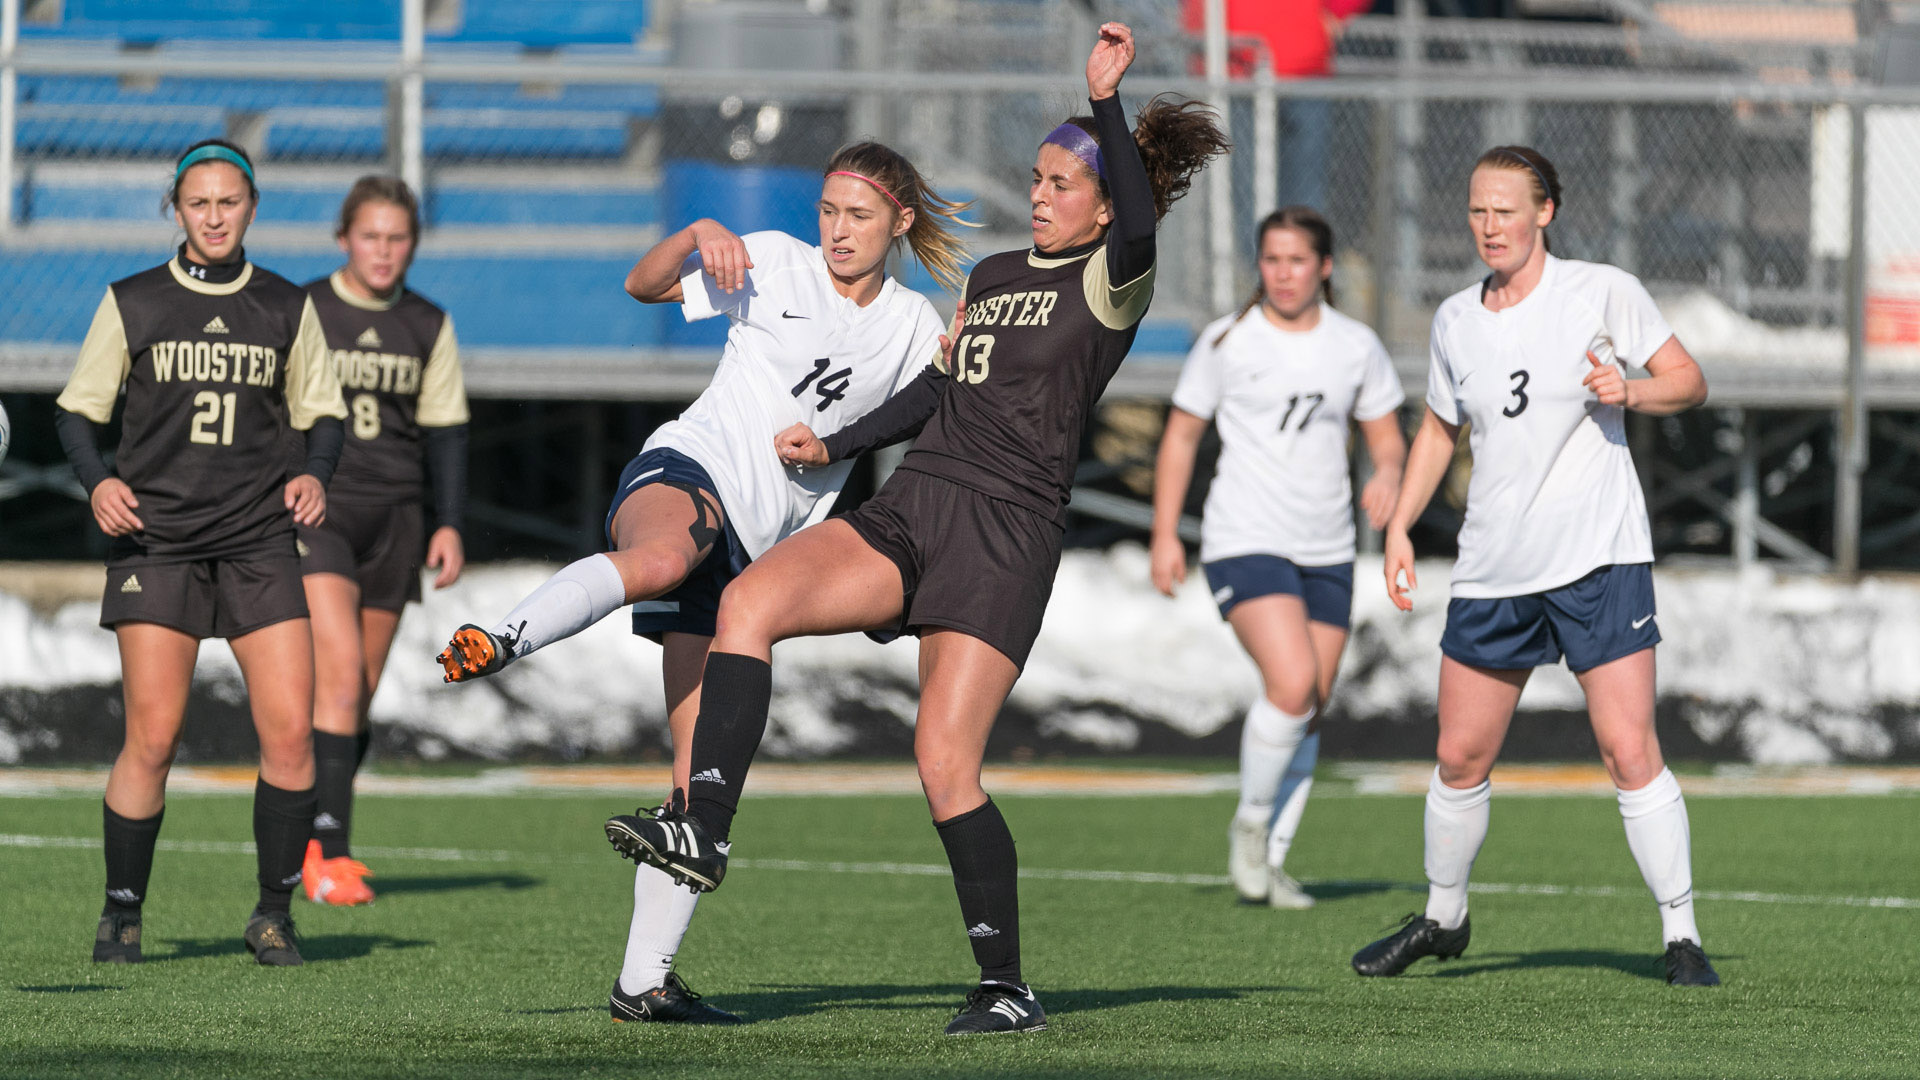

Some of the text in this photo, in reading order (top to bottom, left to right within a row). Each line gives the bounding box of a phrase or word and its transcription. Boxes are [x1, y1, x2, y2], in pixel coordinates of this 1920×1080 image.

[152, 341, 277, 387] WOOSTER
[957, 334, 996, 384] 13
[791, 358, 852, 412] 14
[1502, 369, 1530, 418] 3
[190, 391, 237, 446] 21
[352, 393, 381, 440] 8
[1279, 393, 1323, 432] 17
[691, 773, 726, 785] adidas
